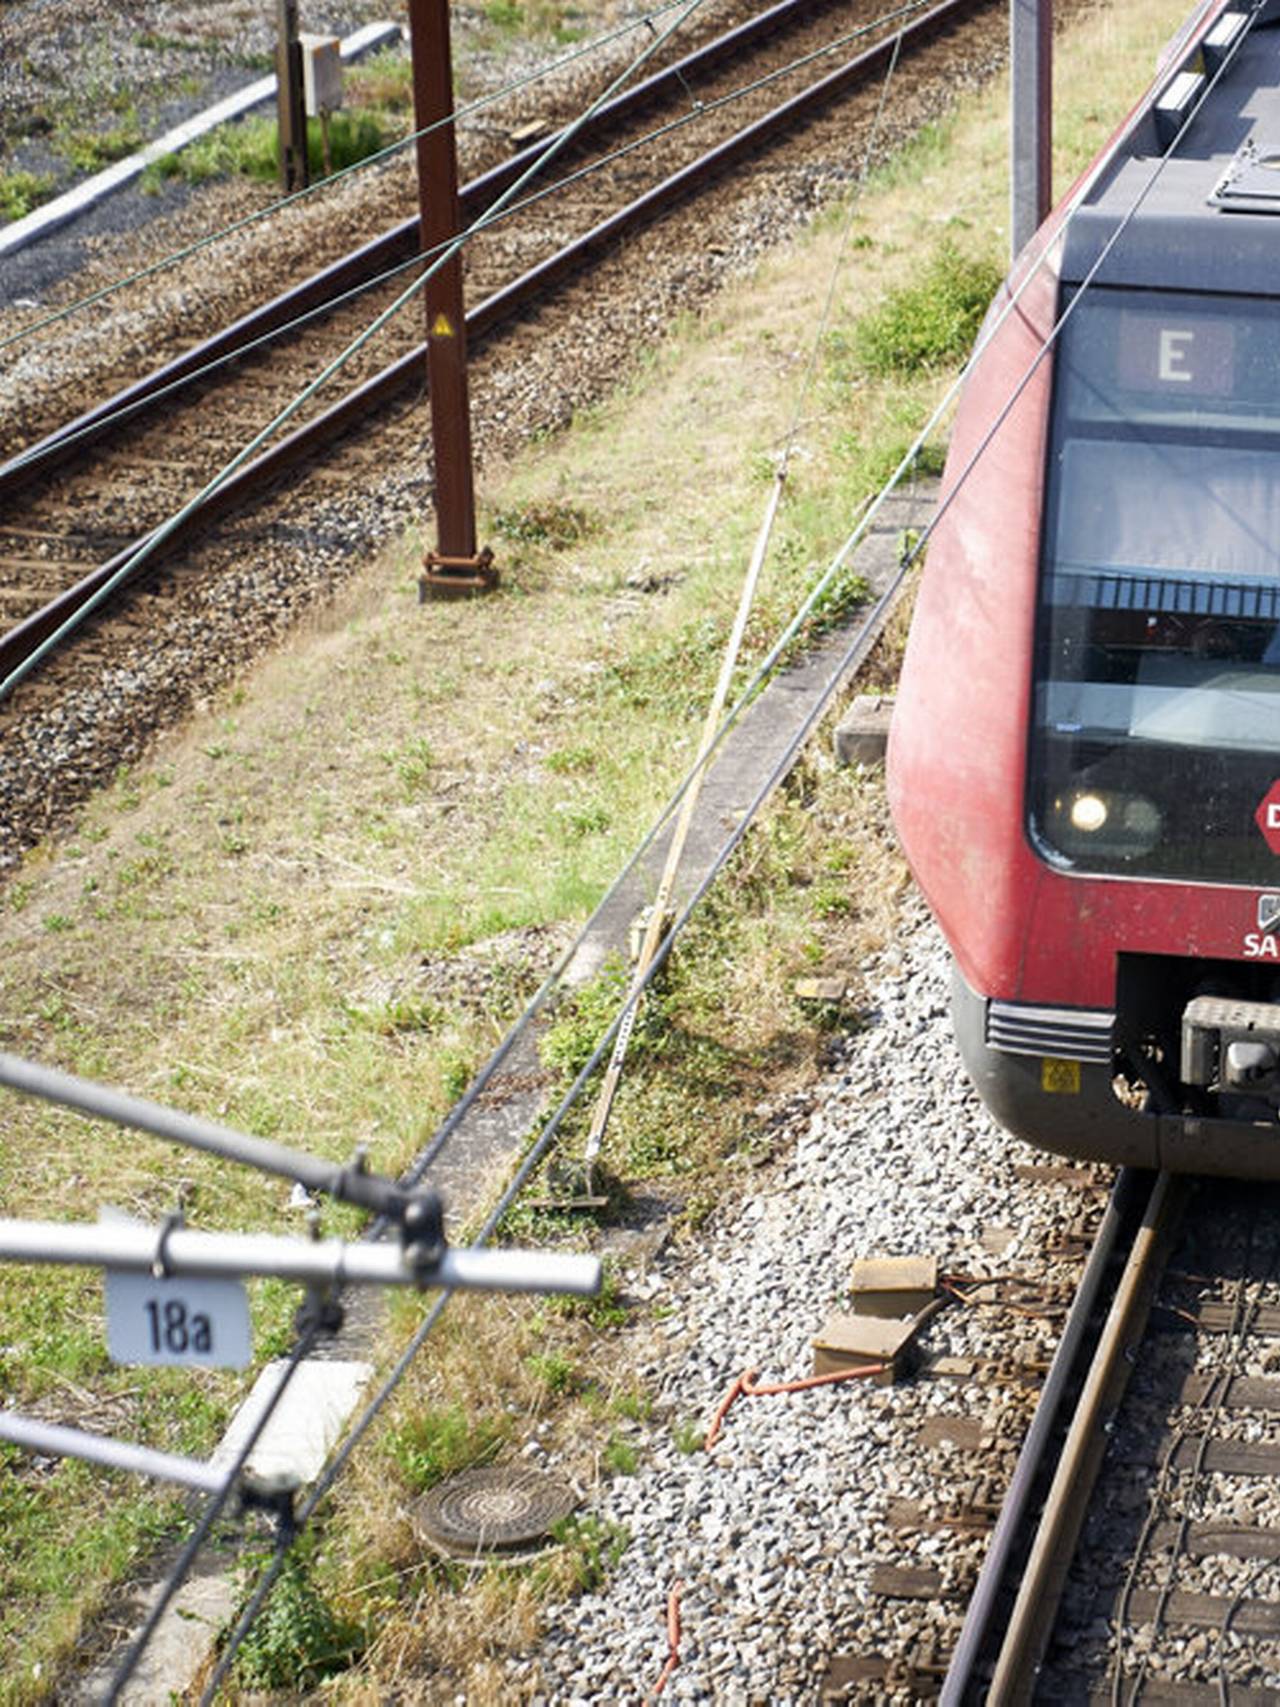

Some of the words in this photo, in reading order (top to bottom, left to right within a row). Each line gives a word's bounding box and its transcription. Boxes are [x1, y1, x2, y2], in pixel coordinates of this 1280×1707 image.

[1159, 330, 1193, 381] E
[1243, 934, 1278, 957] SA
[145, 1299, 213, 1354] 18a
